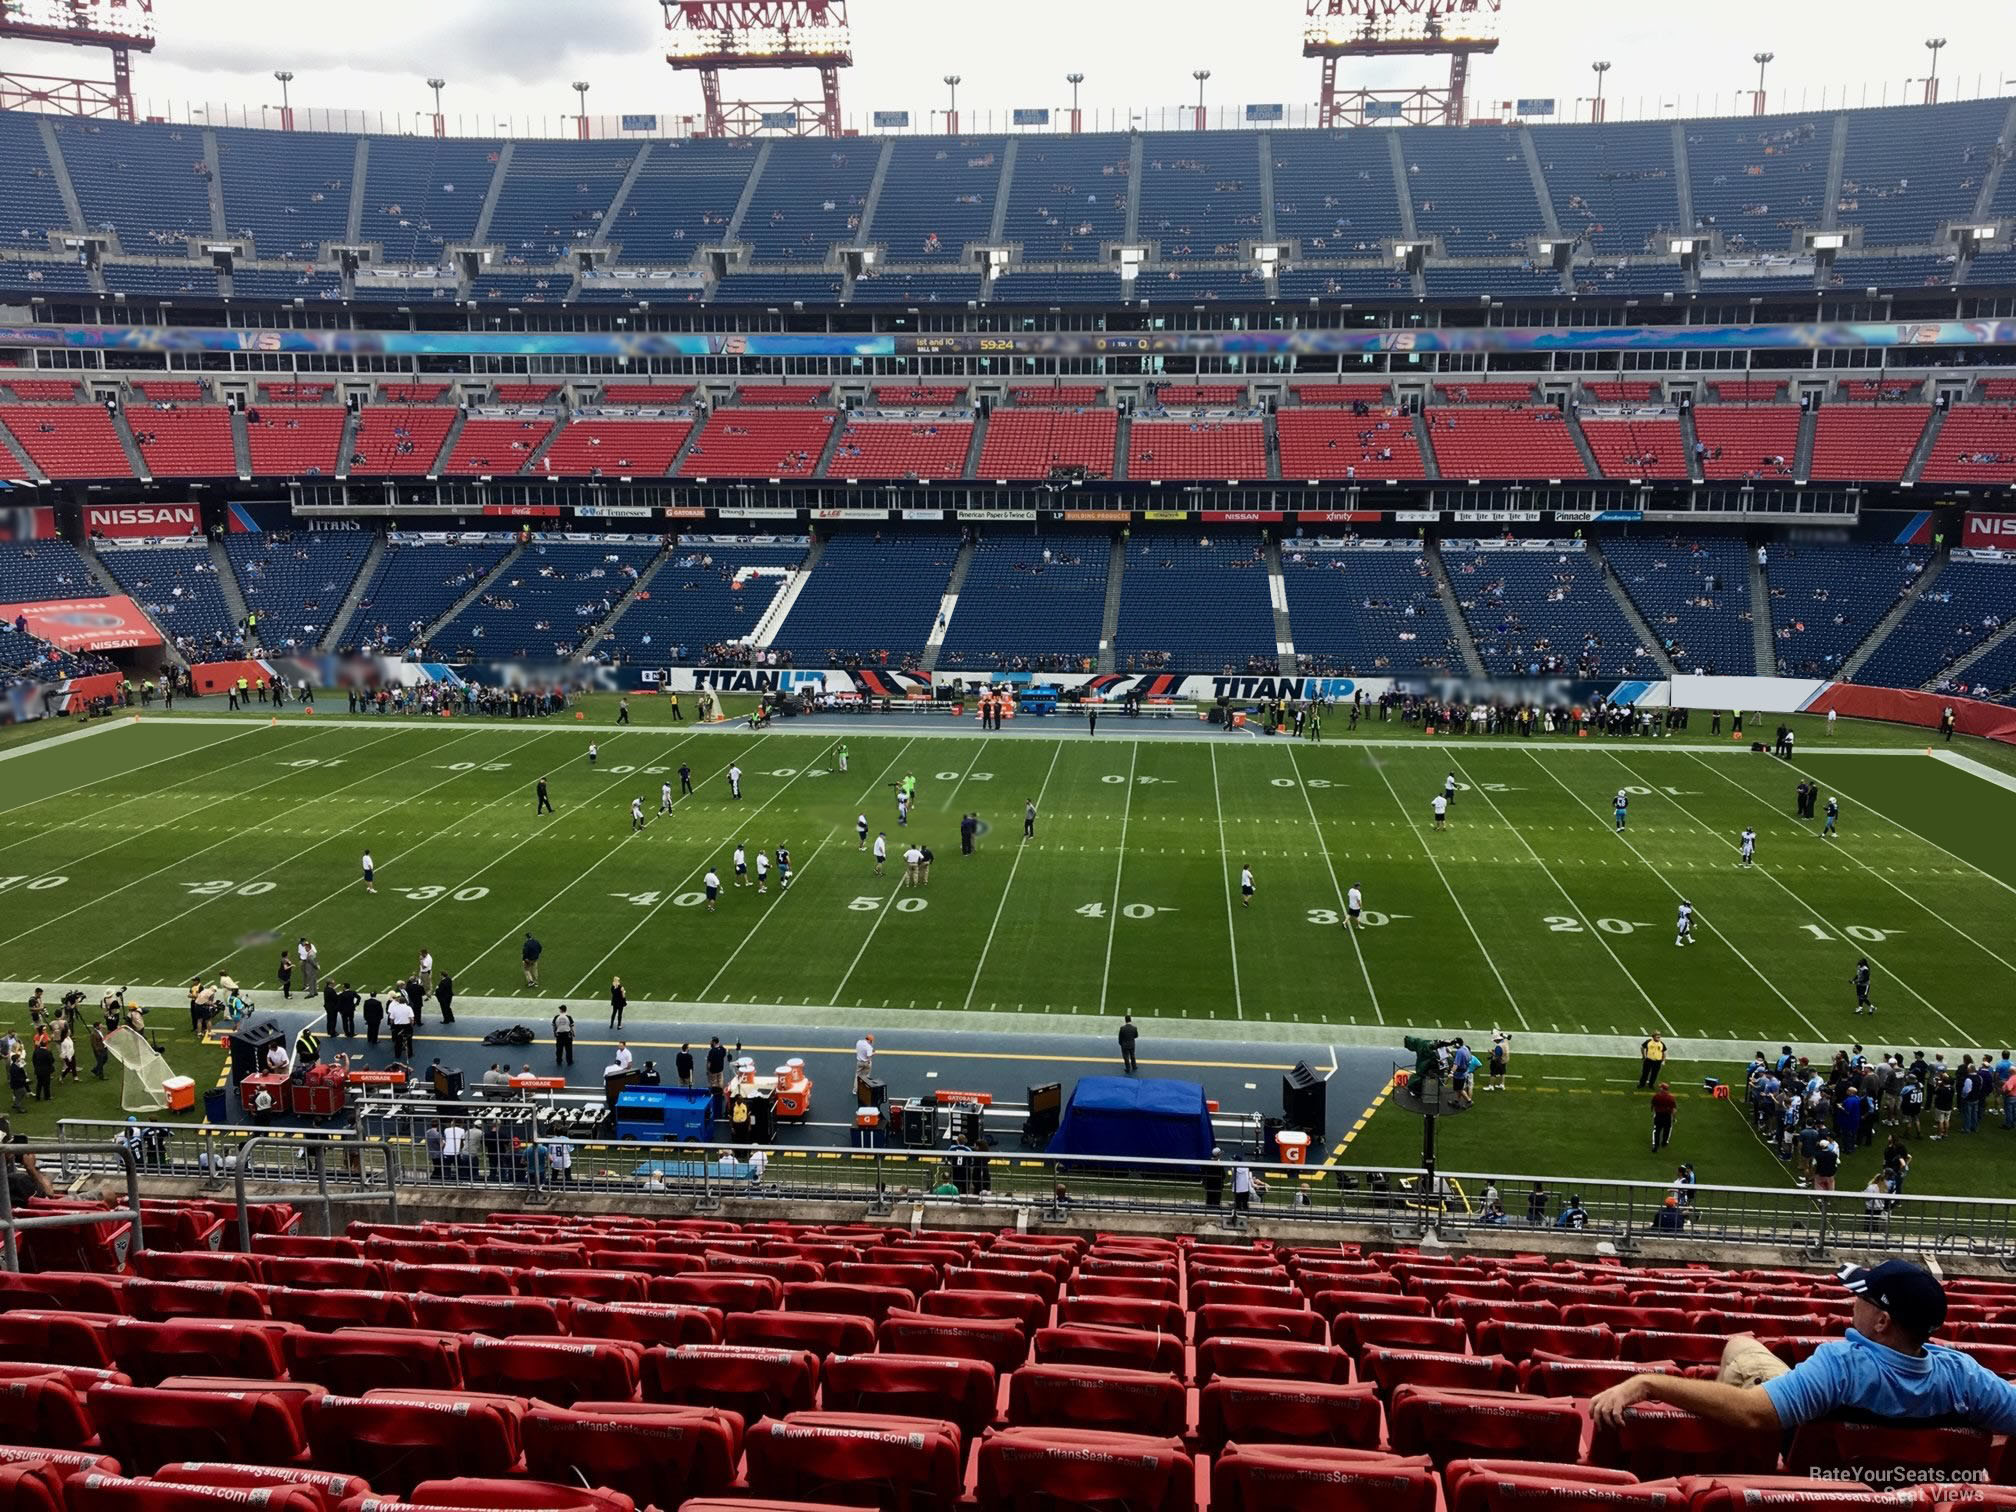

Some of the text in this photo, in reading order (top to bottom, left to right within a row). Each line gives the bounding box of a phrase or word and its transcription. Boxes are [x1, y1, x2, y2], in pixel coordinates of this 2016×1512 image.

[238, 332, 281, 350] VS
[1897, 325, 1941, 344] VS
[707, 336, 746, 353] VS
[1379, 333, 1416, 350] VS
[91, 508, 194, 525] NISSAN
[607, 509, 646, 517] Tennessee
[958, 510, 986, 519] American
[987, 511, 1003, 520] Paper
[1009, 511, 1025, 519] Twine
[1053, 512, 1064, 520] LP
[1096, 512, 1129, 520] PRODUCTS
[1326, 512, 1352, 521] xfinity
[1555, 511, 1591, 521] Pinnacle
[308, 519, 361, 532] TITANS
[22, 602, 107, 614] NISSAN
[61, 629, 147, 642] NISSAN
[90, 639, 139, 650] NISSAN
[847, 896, 928, 912] 50
[1075, 902, 1155, 919] 40
[1543, 916, 1634, 934] 20
[1715, 1087, 1729, 1099] 20
[1910, 1092, 1923, 1103] 90
[1396, 1094, 1409, 1108] 30
[1286, 1147, 1300, 1160] G
[1391, 1352, 1482, 1367] www.TitansSeats.com
[786, 1427, 907, 1446] www.TitansSeats.com
